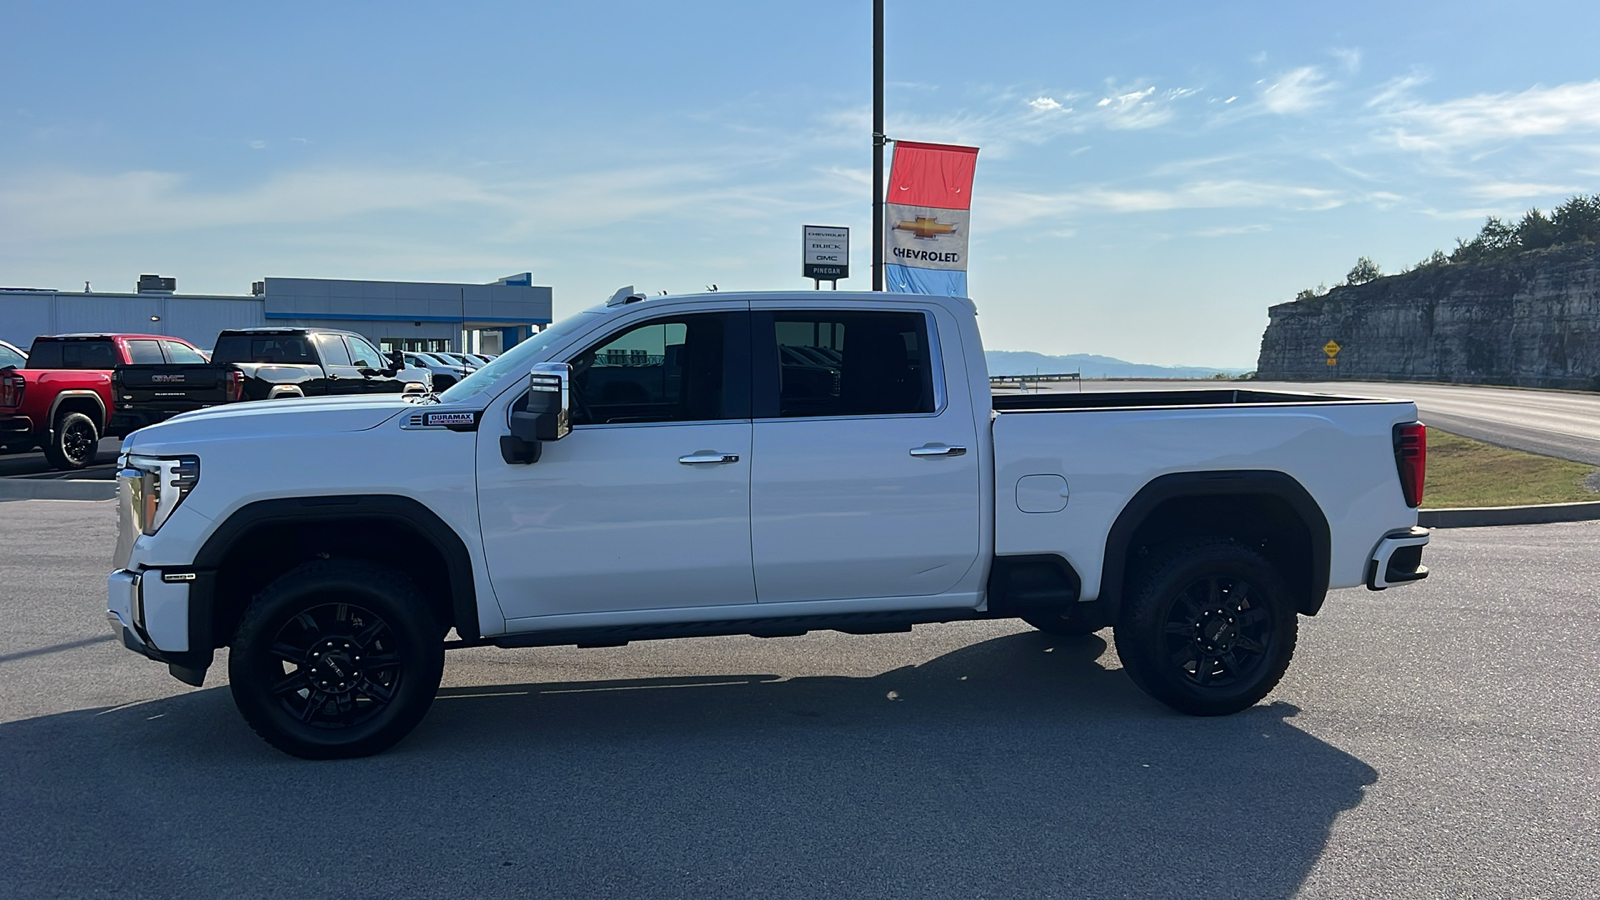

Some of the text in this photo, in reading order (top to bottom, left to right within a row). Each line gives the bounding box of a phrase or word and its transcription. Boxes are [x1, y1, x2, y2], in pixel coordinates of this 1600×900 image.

[893, 247, 958, 262] CHEVROLET
[813, 267, 841, 275] PINEGAR
[151, 374, 185, 382] GMC
